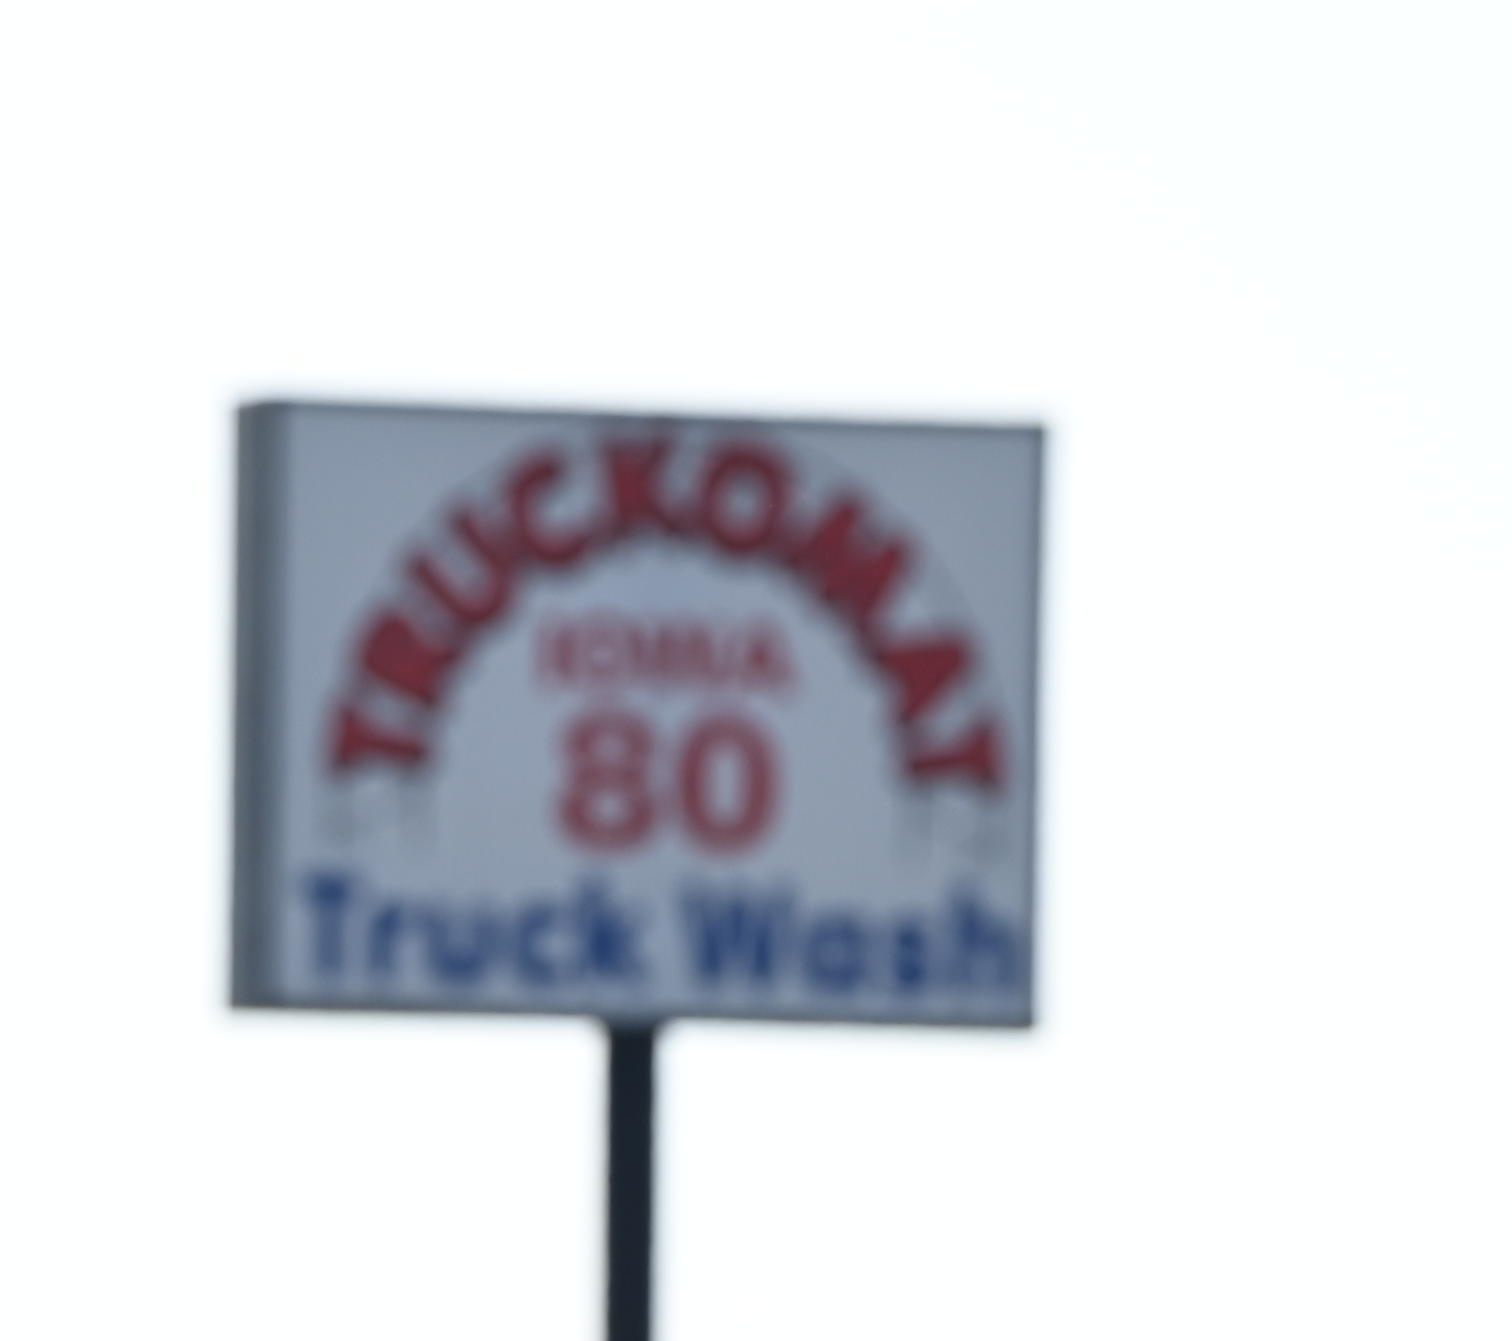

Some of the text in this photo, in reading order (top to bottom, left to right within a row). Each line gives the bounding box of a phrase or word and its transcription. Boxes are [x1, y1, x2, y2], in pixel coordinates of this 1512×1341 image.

[324, 420, 1006, 792] TRUCKOMAT
[558, 706, 780, 858] 80
[304, 872, 1022, 992] Truck Wash
